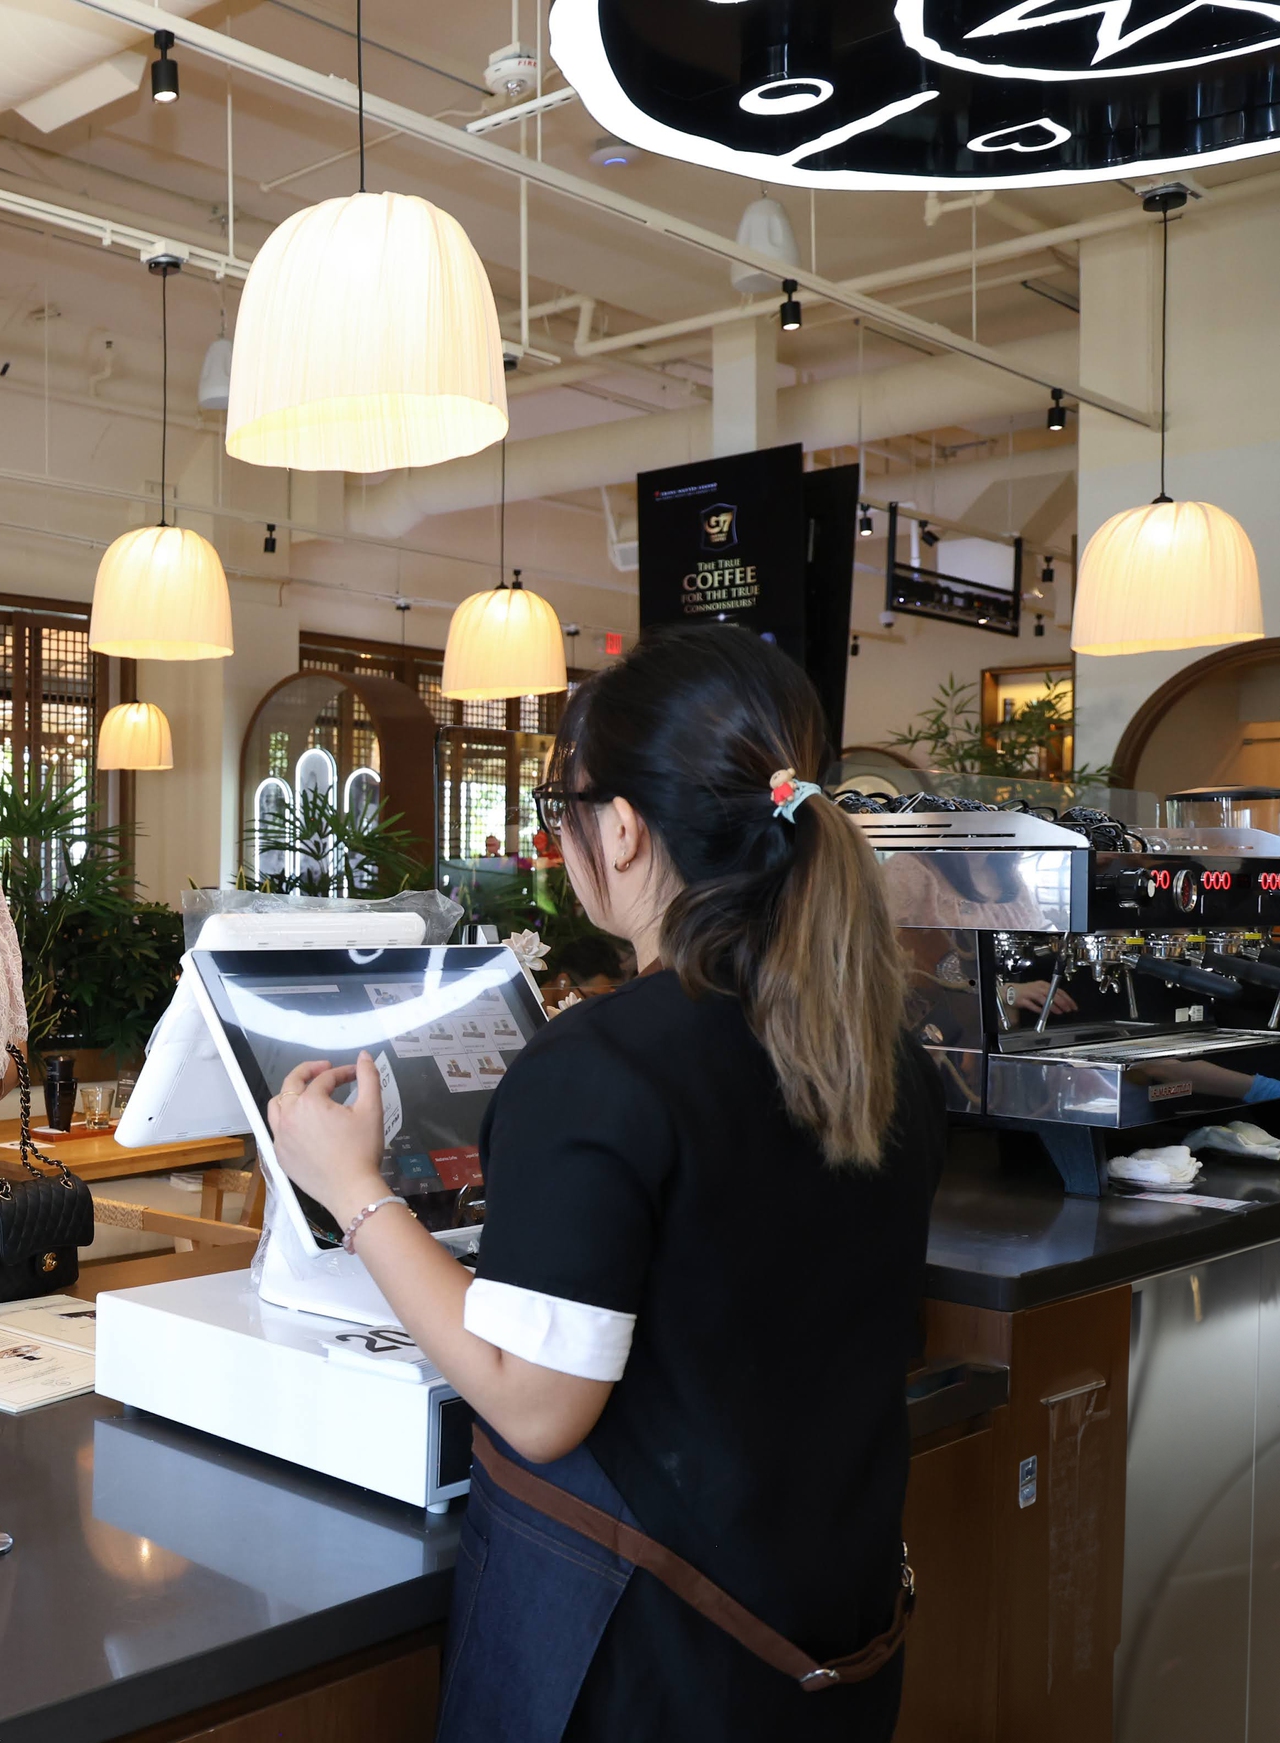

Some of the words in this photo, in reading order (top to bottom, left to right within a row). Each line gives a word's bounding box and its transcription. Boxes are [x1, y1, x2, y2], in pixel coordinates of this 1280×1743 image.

[518, 60, 537, 69] FIRE
[697, 561, 716, 572] THE
[718, 557, 742, 570] TRUE
[683, 565, 757, 591] COFFEE
[705, 588, 729, 601] THE
[730, 584, 761, 598] TRUE
[335, 1329, 418, 1353] 20
